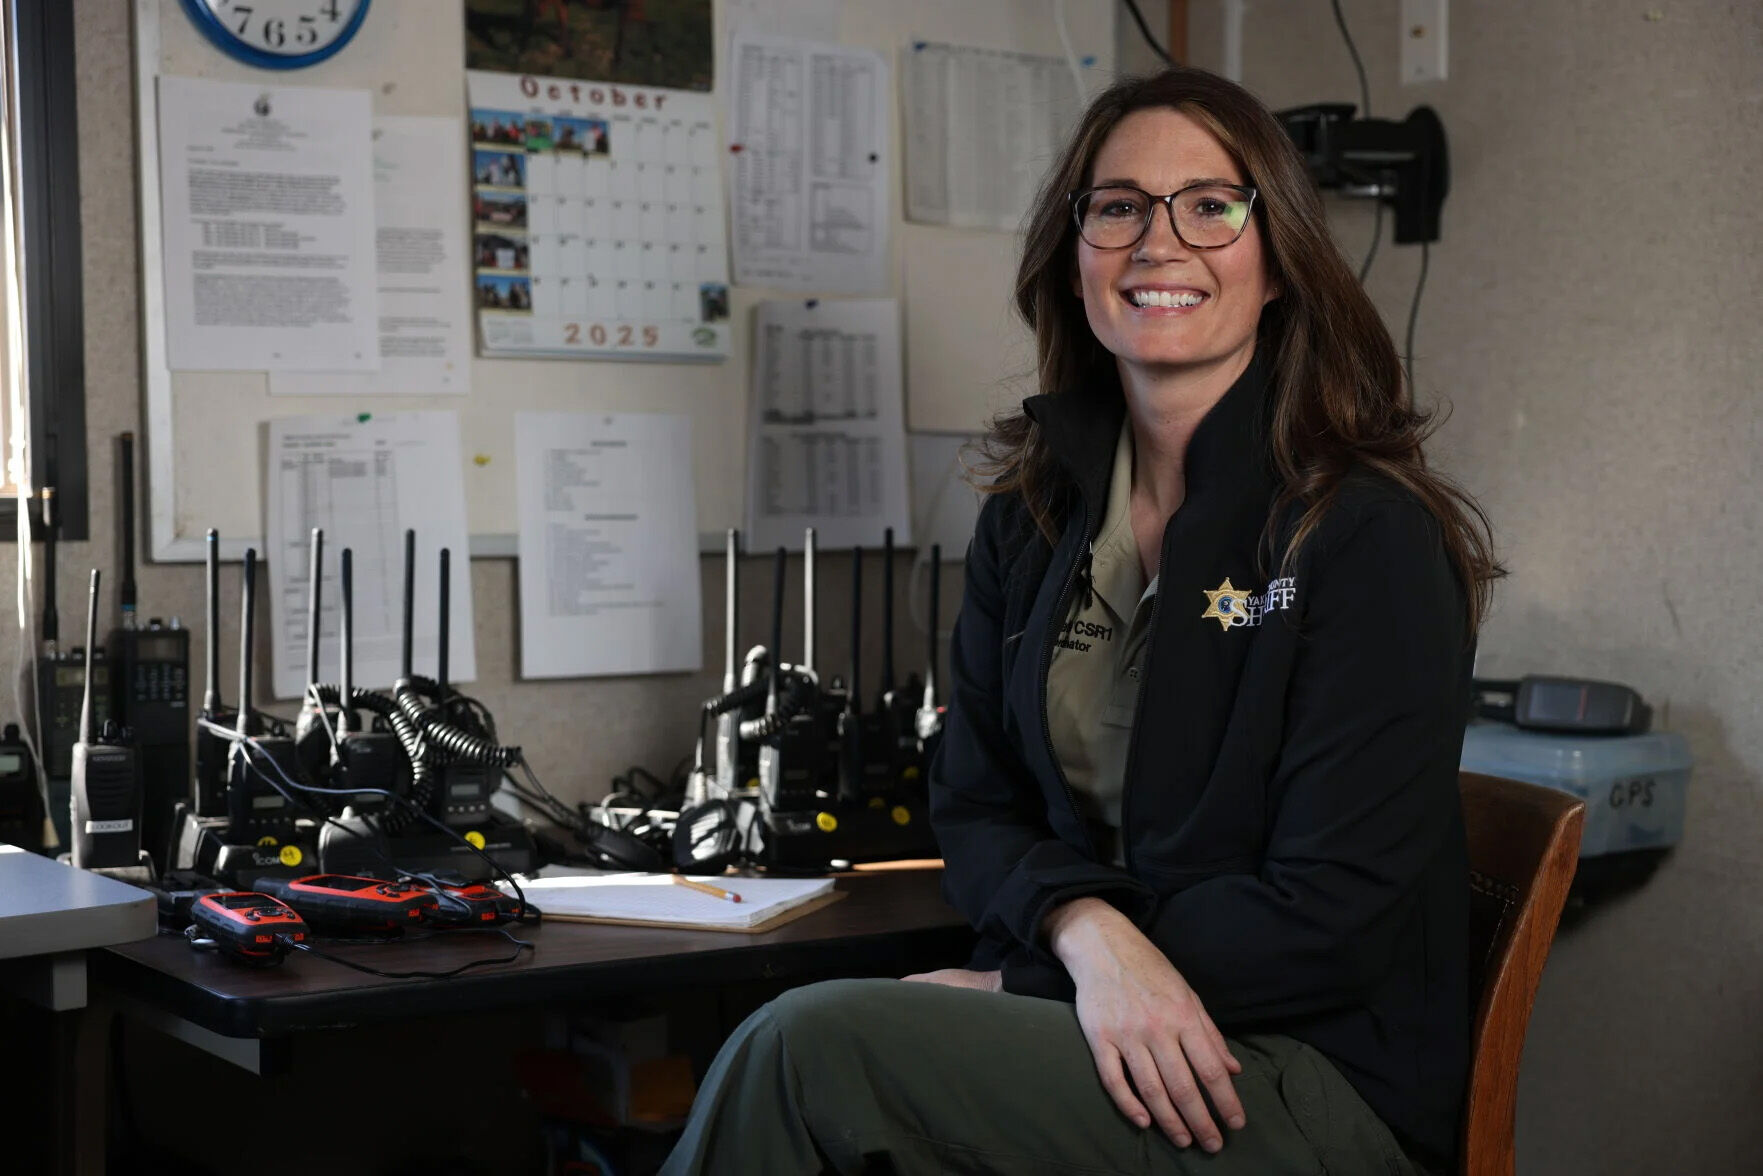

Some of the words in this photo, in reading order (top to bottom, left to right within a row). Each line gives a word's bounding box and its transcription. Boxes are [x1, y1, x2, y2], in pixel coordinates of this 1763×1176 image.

[233, 5, 253, 35] 7
[319, 0, 342, 22] 4
[264, 17, 286, 48] 6
[296, 15, 318, 45] 5
[519, 75, 666, 111] October
[563, 322, 660, 348] 2025
[1230, 587, 1297, 627] SHIFF
[1074, 620, 1113, 642] CSR1
[1608, 779, 1657, 809] GPS
